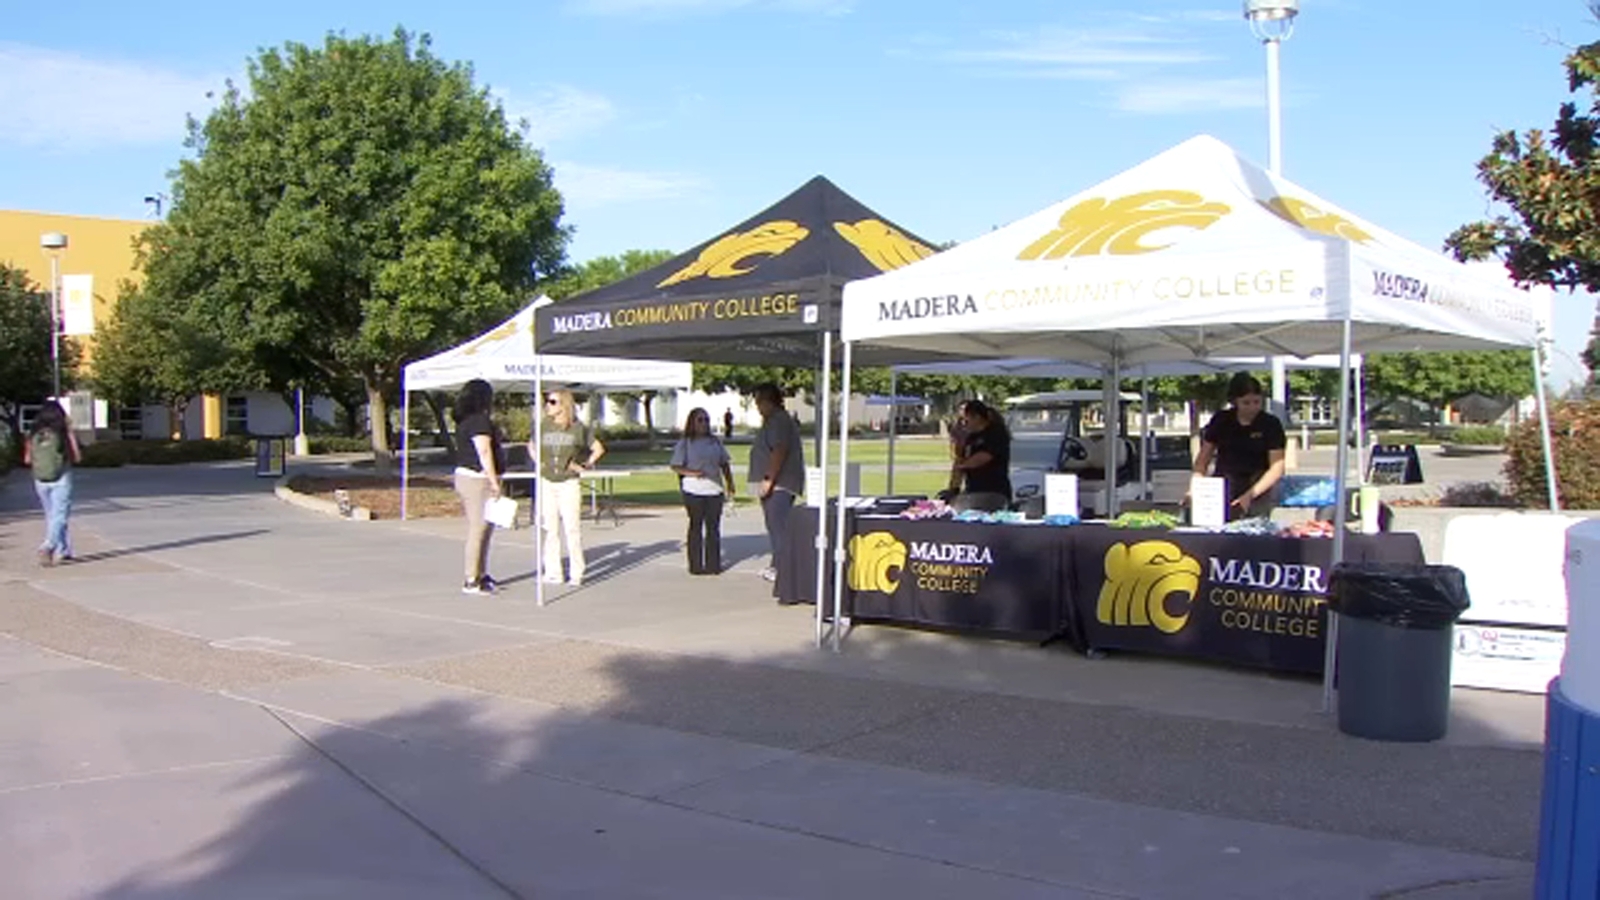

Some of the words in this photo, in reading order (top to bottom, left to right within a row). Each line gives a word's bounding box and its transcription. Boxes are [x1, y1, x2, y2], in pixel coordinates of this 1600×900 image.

[877, 293, 978, 322] MADERA
[983, 278, 1144, 313] COMMUNITY
[1150, 267, 1297, 301] COLLEGE
[1372, 269, 1429, 304] MADERA
[552, 311, 614, 334] MADERA
[615, 300, 711, 326] COMMUNITY
[714, 294, 799, 320] COLLEGE
[910, 541, 994, 564] MADERA
[911, 561, 988, 579] COMMUNITY
[917, 577, 978, 593] COLLEGE
[1208, 556, 1328, 593] MADER
[1209, 586, 1328, 616] COMMUNIT
[1221, 609, 1319, 638] COLLEGE
